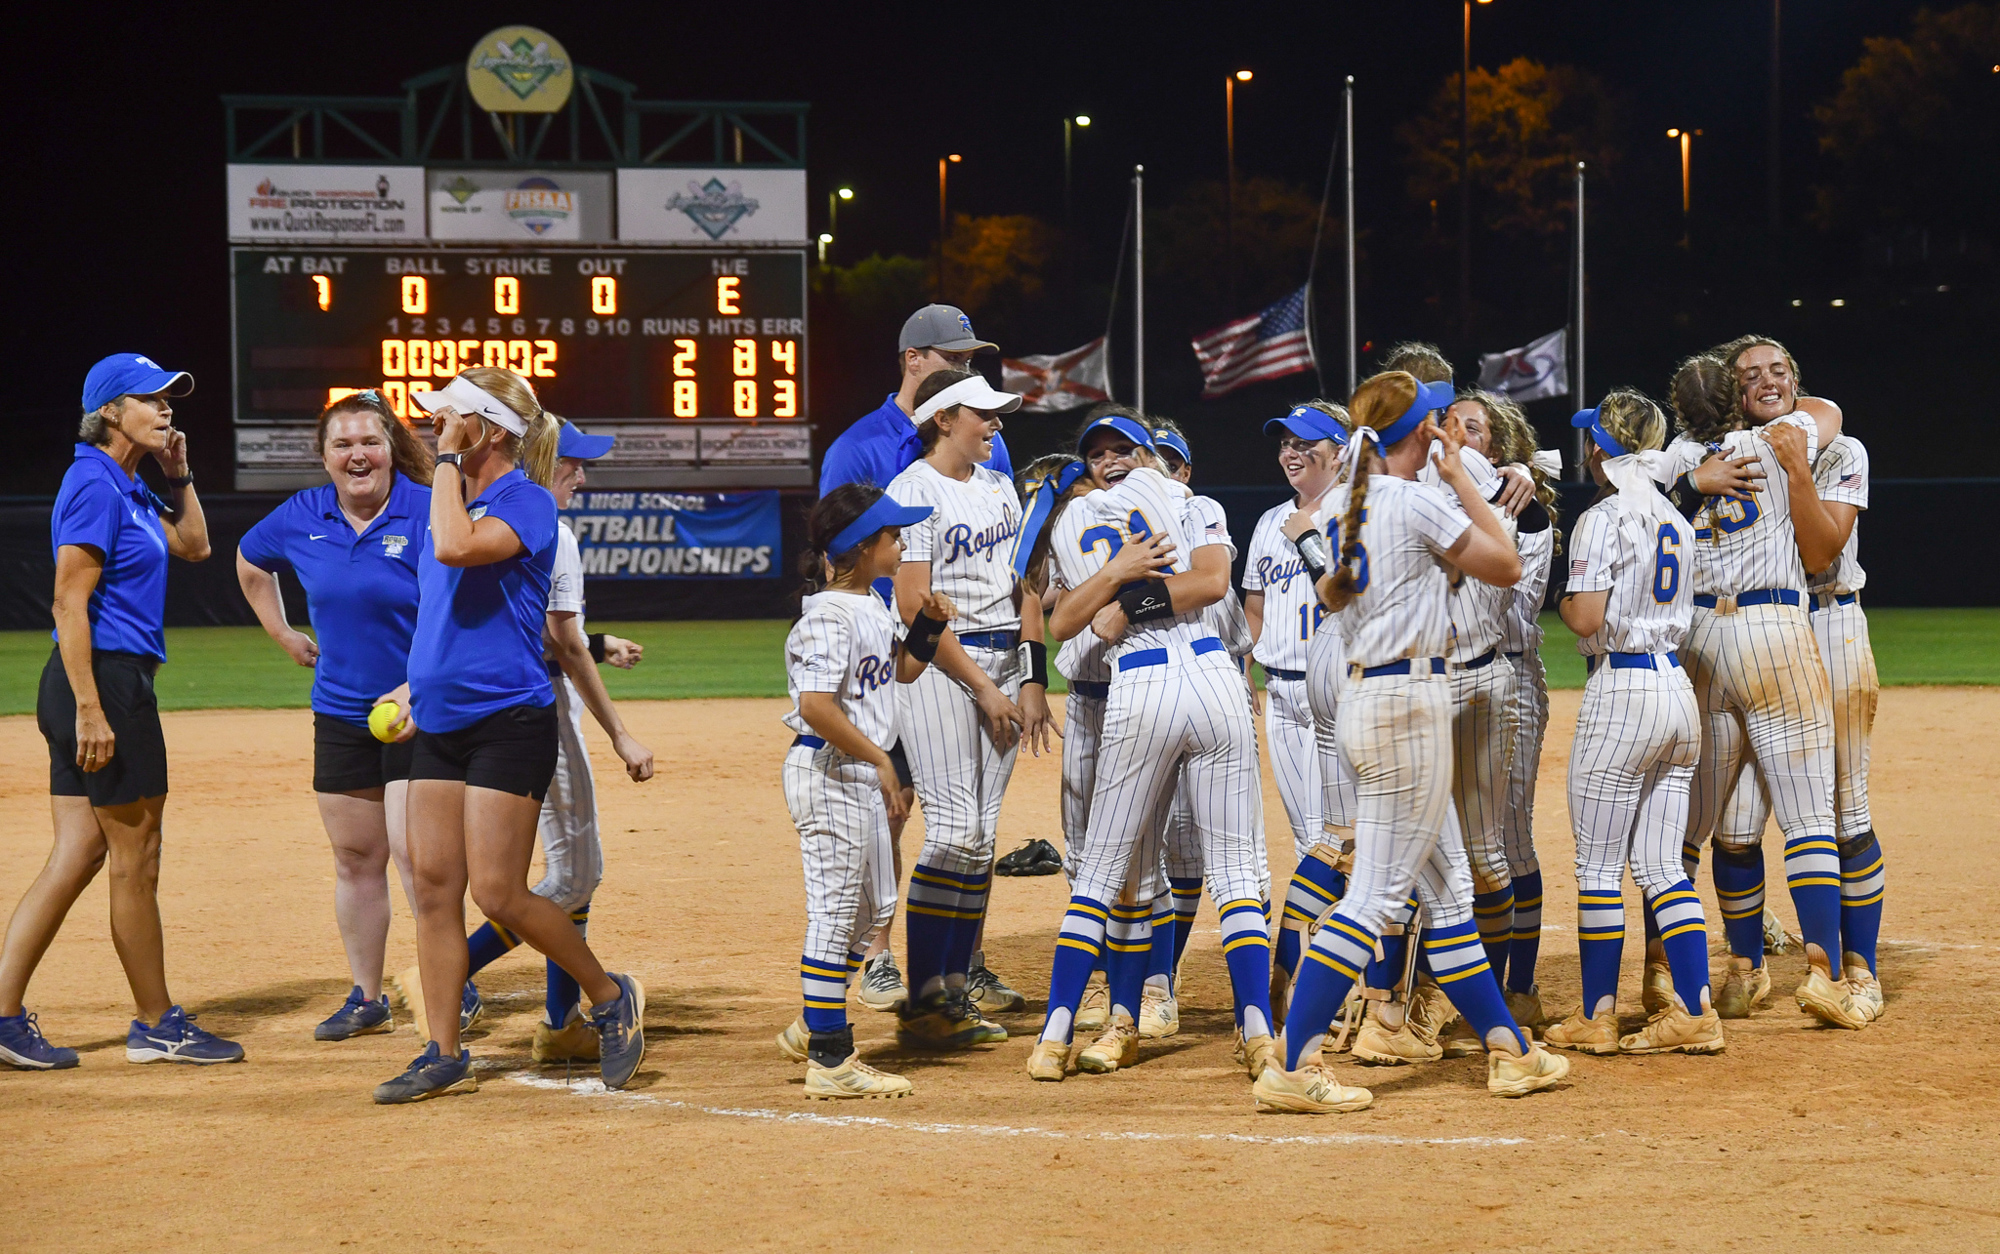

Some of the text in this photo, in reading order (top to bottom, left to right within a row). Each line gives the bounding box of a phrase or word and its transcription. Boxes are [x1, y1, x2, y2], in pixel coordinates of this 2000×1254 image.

[248, 197, 405, 210] FIRE PROTECTION
[506, 189, 572, 211] FHSAA
[250, 211, 406, 232] www.QuickResponseFL.com
[263, 256, 348, 274] AT BAT
[386, 257, 445, 275] BALL
[465, 257, 551, 275] STRIKE
[578, 258, 627, 275] OUT
[712, 258, 749, 276] H/E
[402, 276, 428, 315] 0
[494, 276, 520, 315] 0
[591, 276, 617, 315] 0
[717, 276, 741, 315] E
[387, 317, 630, 335] 1 2 3 4 5 6 7 8 9 10
[642, 318, 803, 336] RUNS HITS ERR
[673, 339, 696, 377] 2
[772, 340, 795, 375] 4
[673, 380, 698, 418] 8
[773, 380, 796, 418] 3
[589, 493, 635, 510] HIGH
[638, 493, 707, 511] SCHOOL
[1652, 521, 1681, 605] 6
[1135, 602, 1167, 614] CUTTERS
